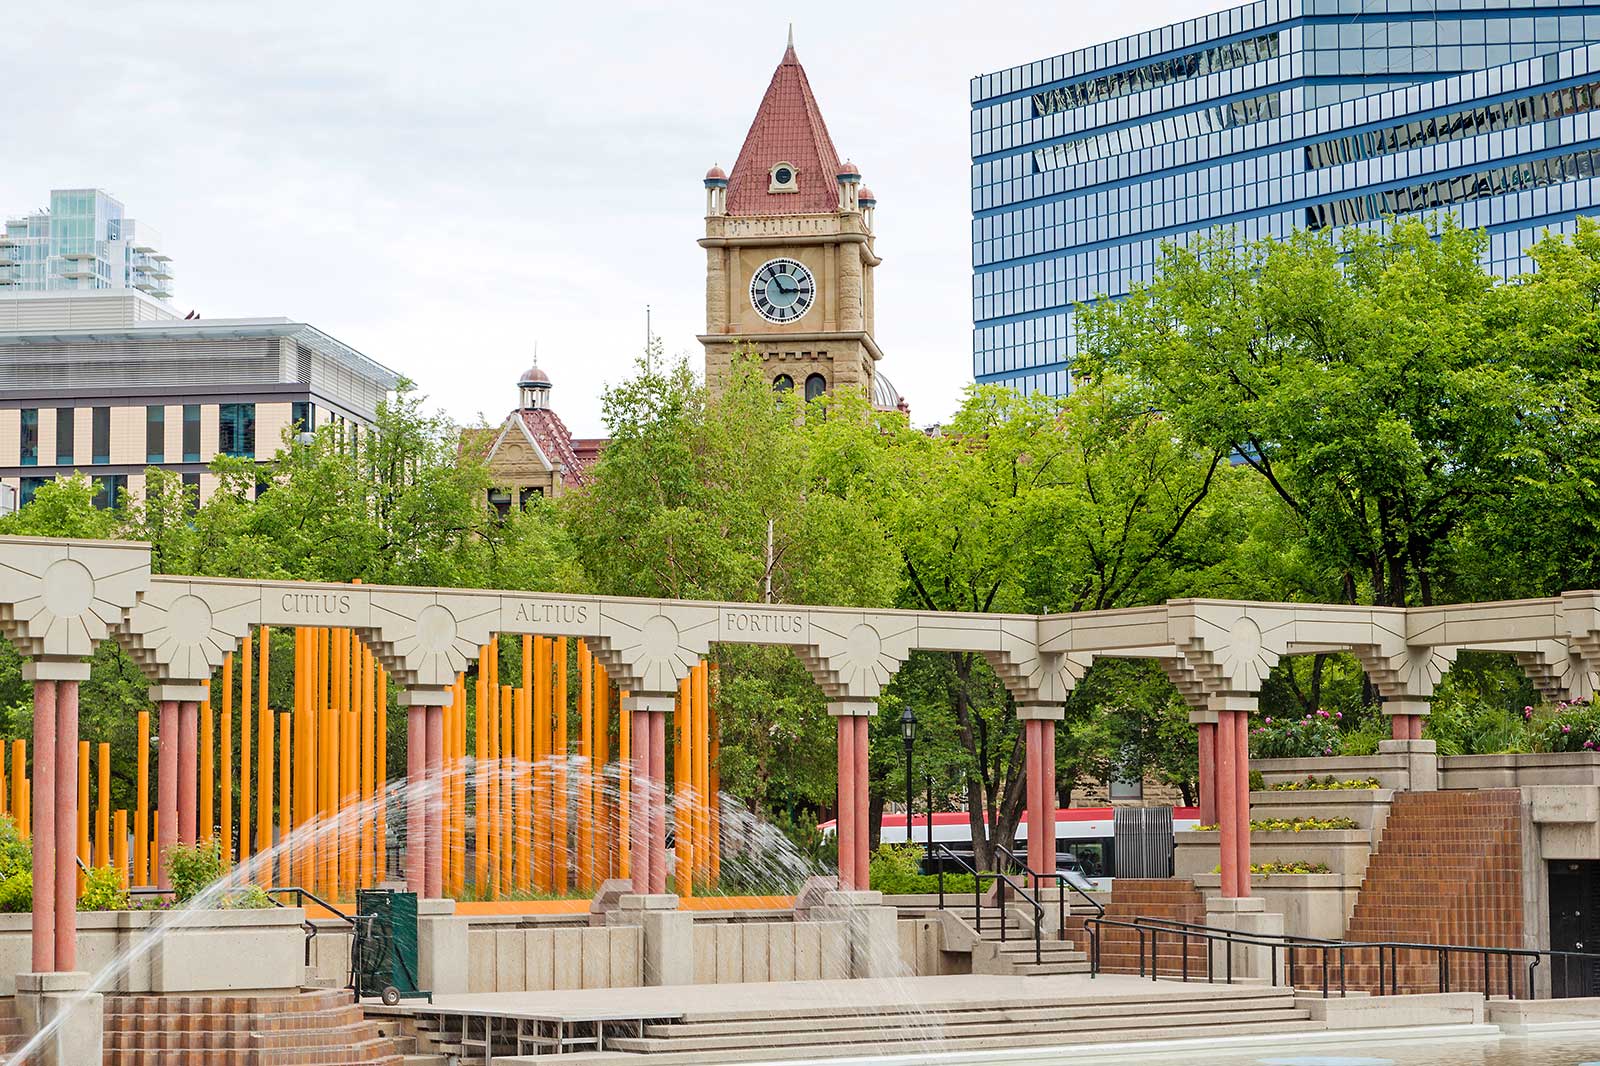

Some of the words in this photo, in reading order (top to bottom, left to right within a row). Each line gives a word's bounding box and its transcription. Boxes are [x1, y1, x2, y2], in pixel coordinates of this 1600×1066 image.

[281, 593, 351, 614] CITIUS
[515, 603, 588, 624] ALTIUS
[726, 613, 803, 633] FORTIUS
